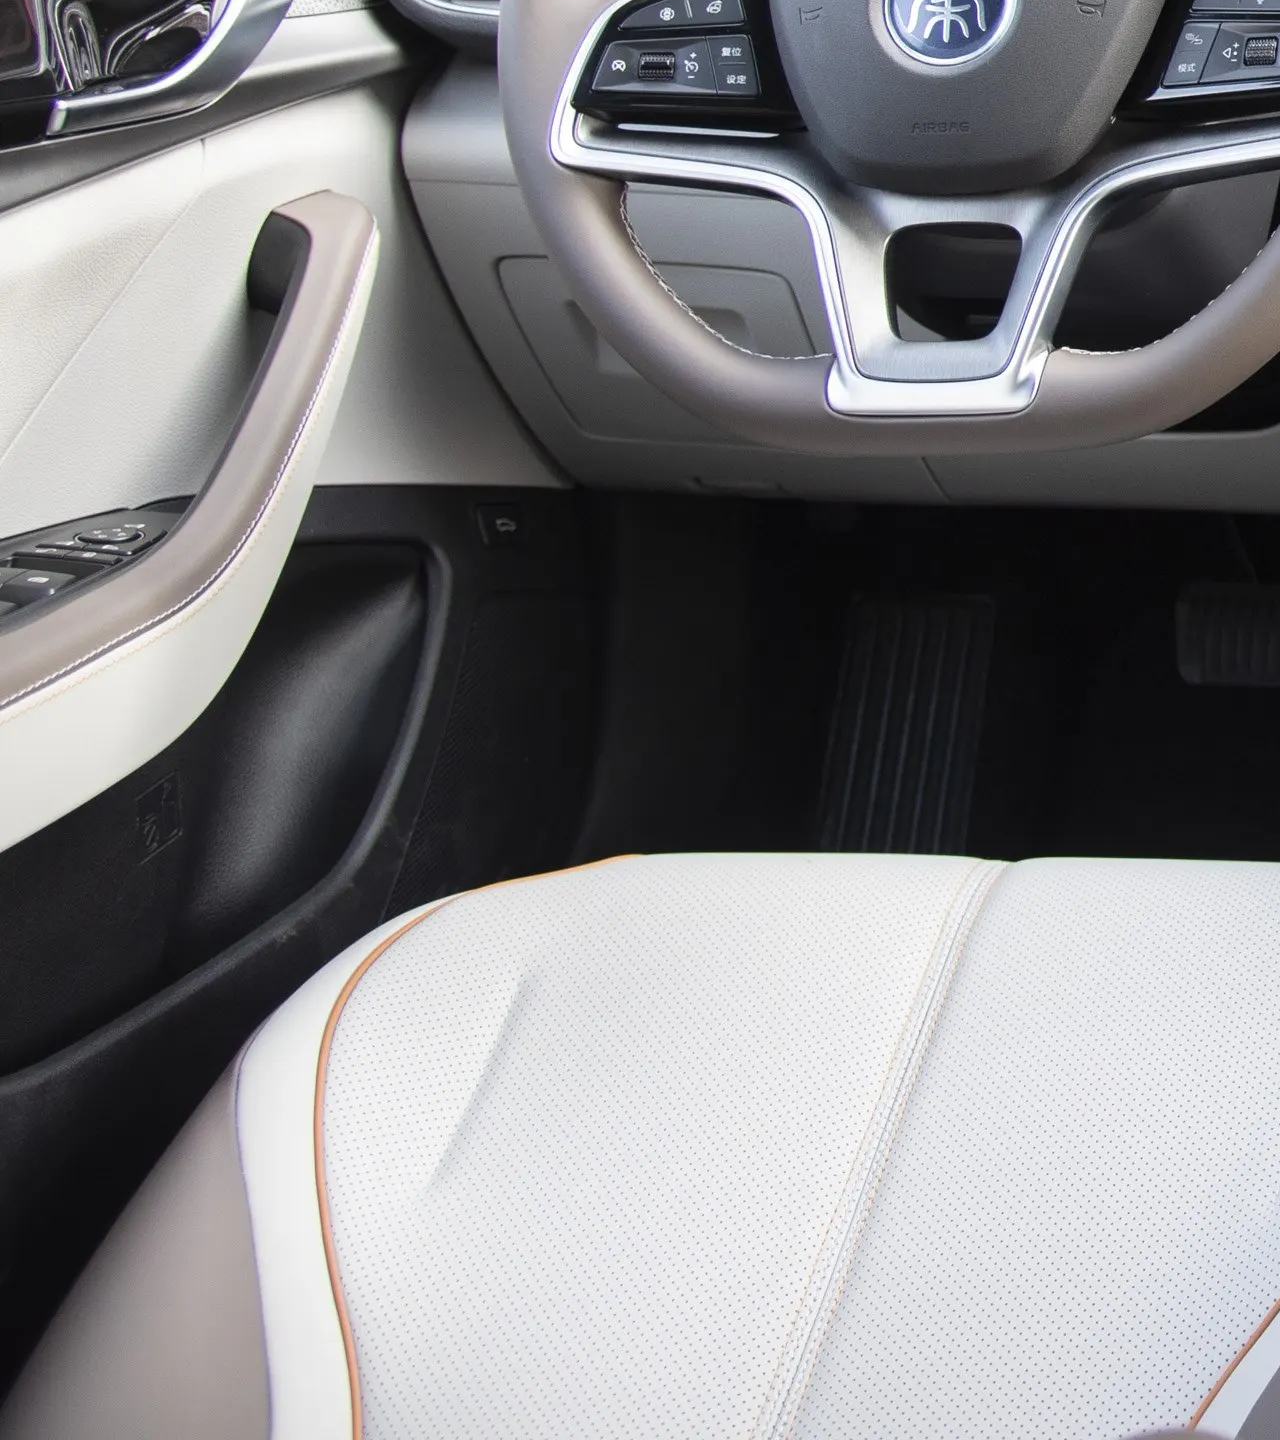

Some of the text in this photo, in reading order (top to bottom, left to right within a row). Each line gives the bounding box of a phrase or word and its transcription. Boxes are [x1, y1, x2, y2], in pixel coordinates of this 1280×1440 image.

[721, 47, 742, 57] 复位
[1178, 63, 1196, 73] 模式
[726, 75, 747, 85] 设定
[911, 122, 970, 134] AIRBAG
